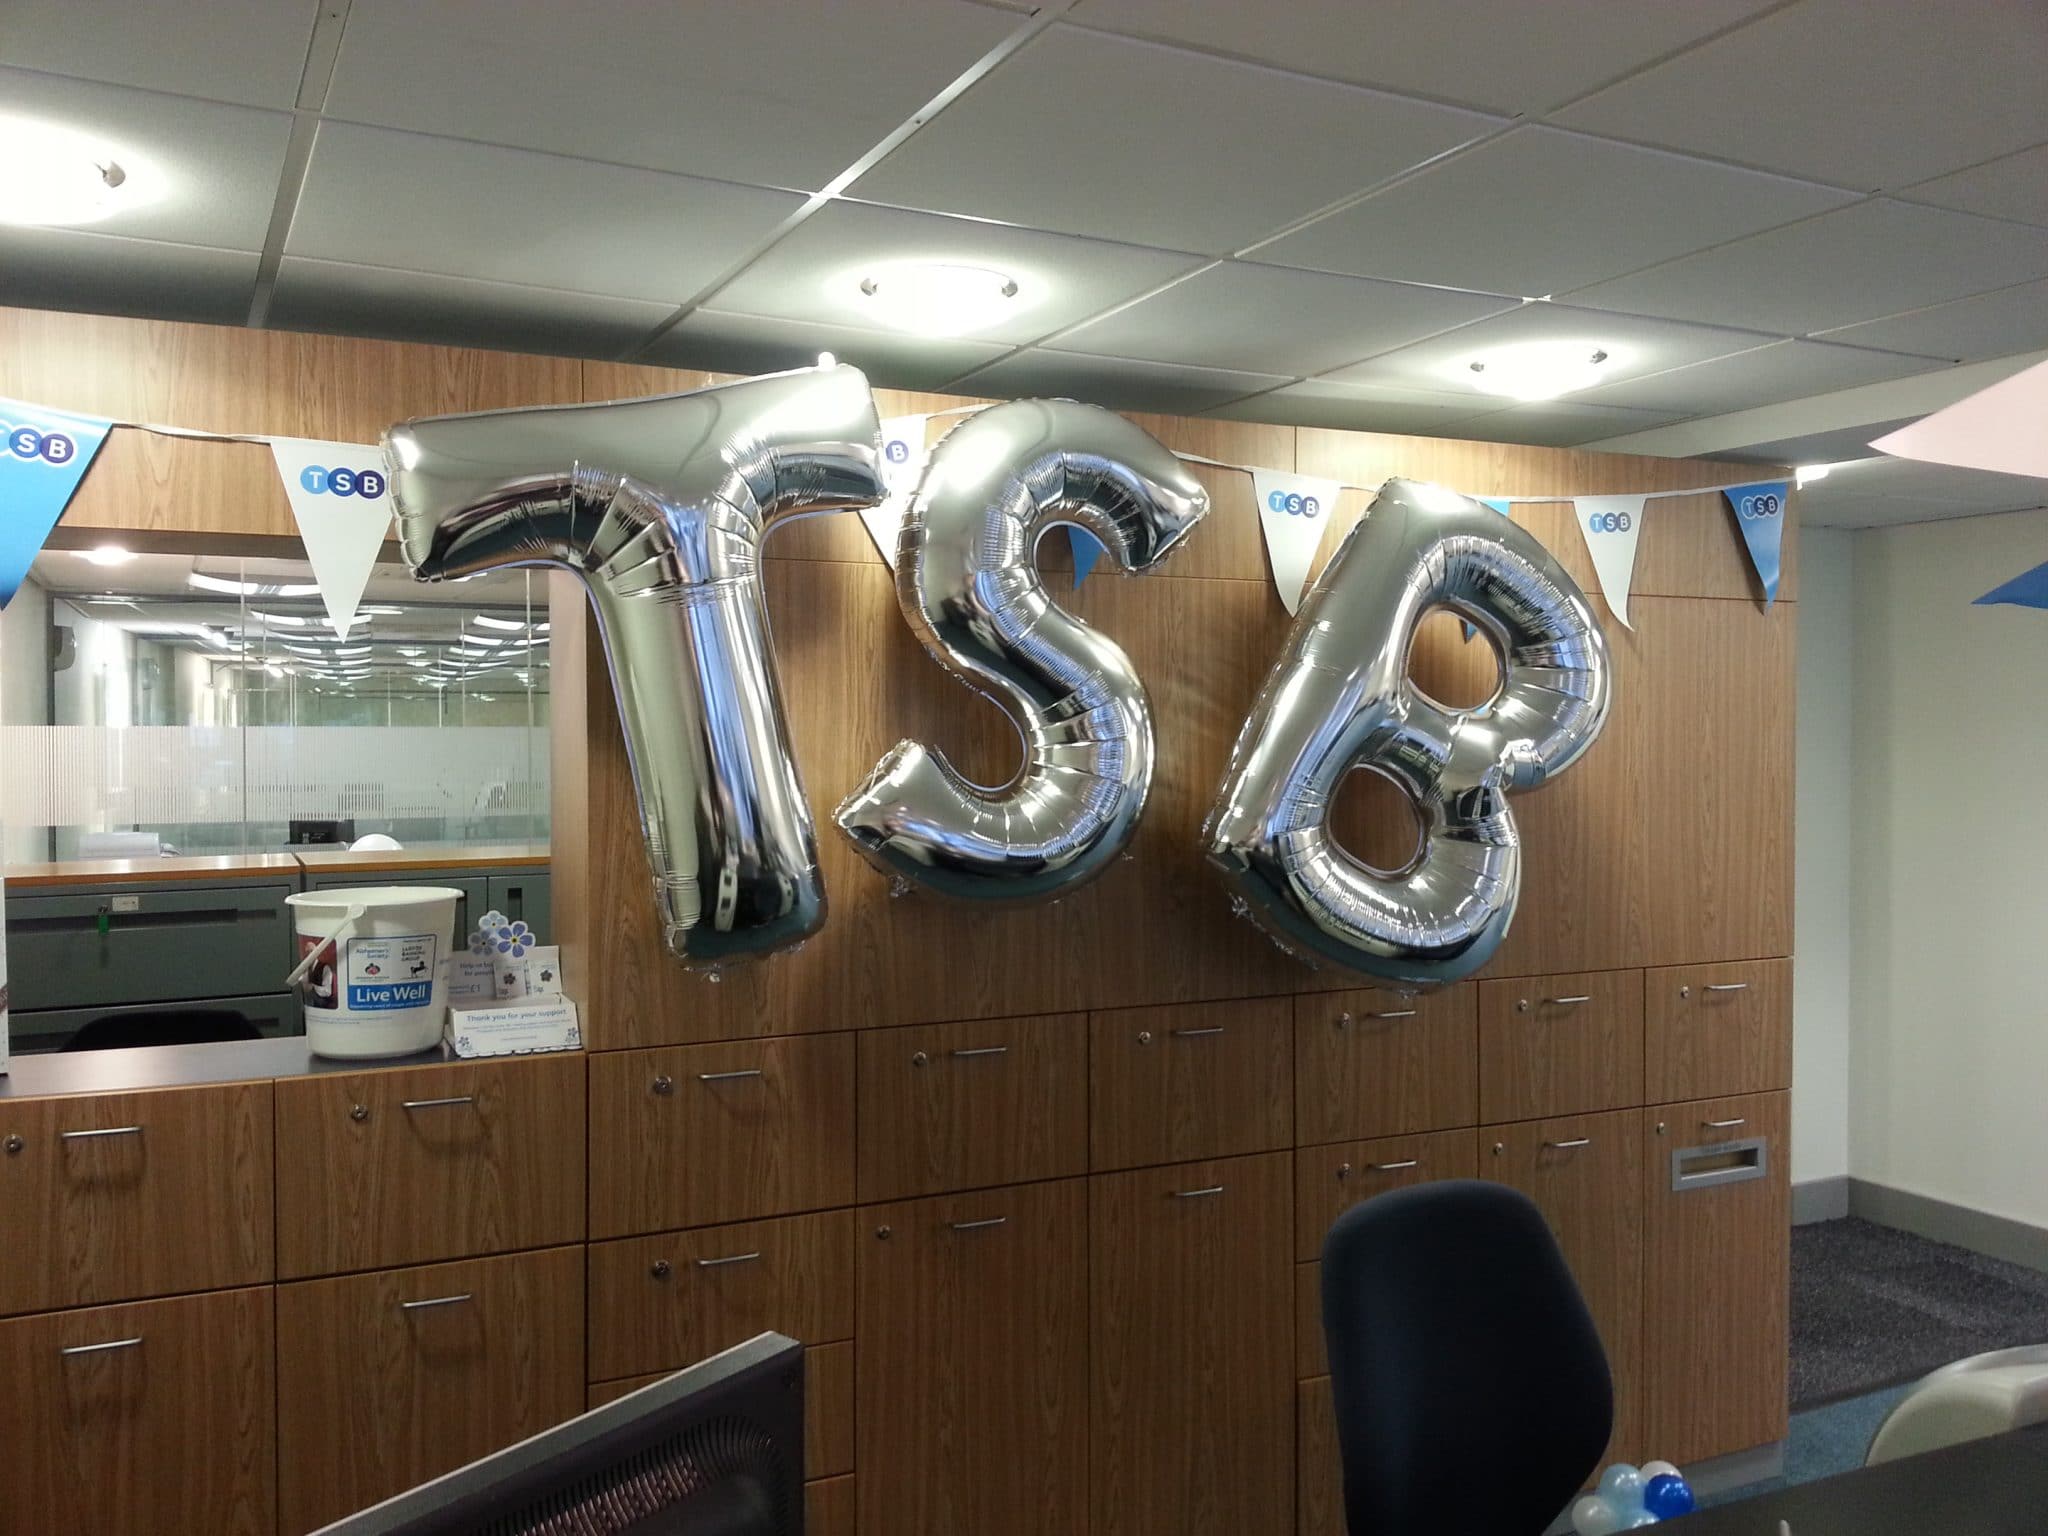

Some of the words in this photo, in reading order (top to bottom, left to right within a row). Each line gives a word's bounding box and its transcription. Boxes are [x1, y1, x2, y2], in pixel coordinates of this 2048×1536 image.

[0, 430, 71, 461] SB
[304, 467, 383, 496] TSB
[1271, 492, 1318, 516] TSB
[1743, 496, 1778, 517] TSB
[1591, 514, 1629, 531] TSB
[356, 987, 390, 1002] Live
[393, 984, 426, 1000] Well
[467, 1014, 492, 1022] Thank
[539, 1009, 566, 1017] support
